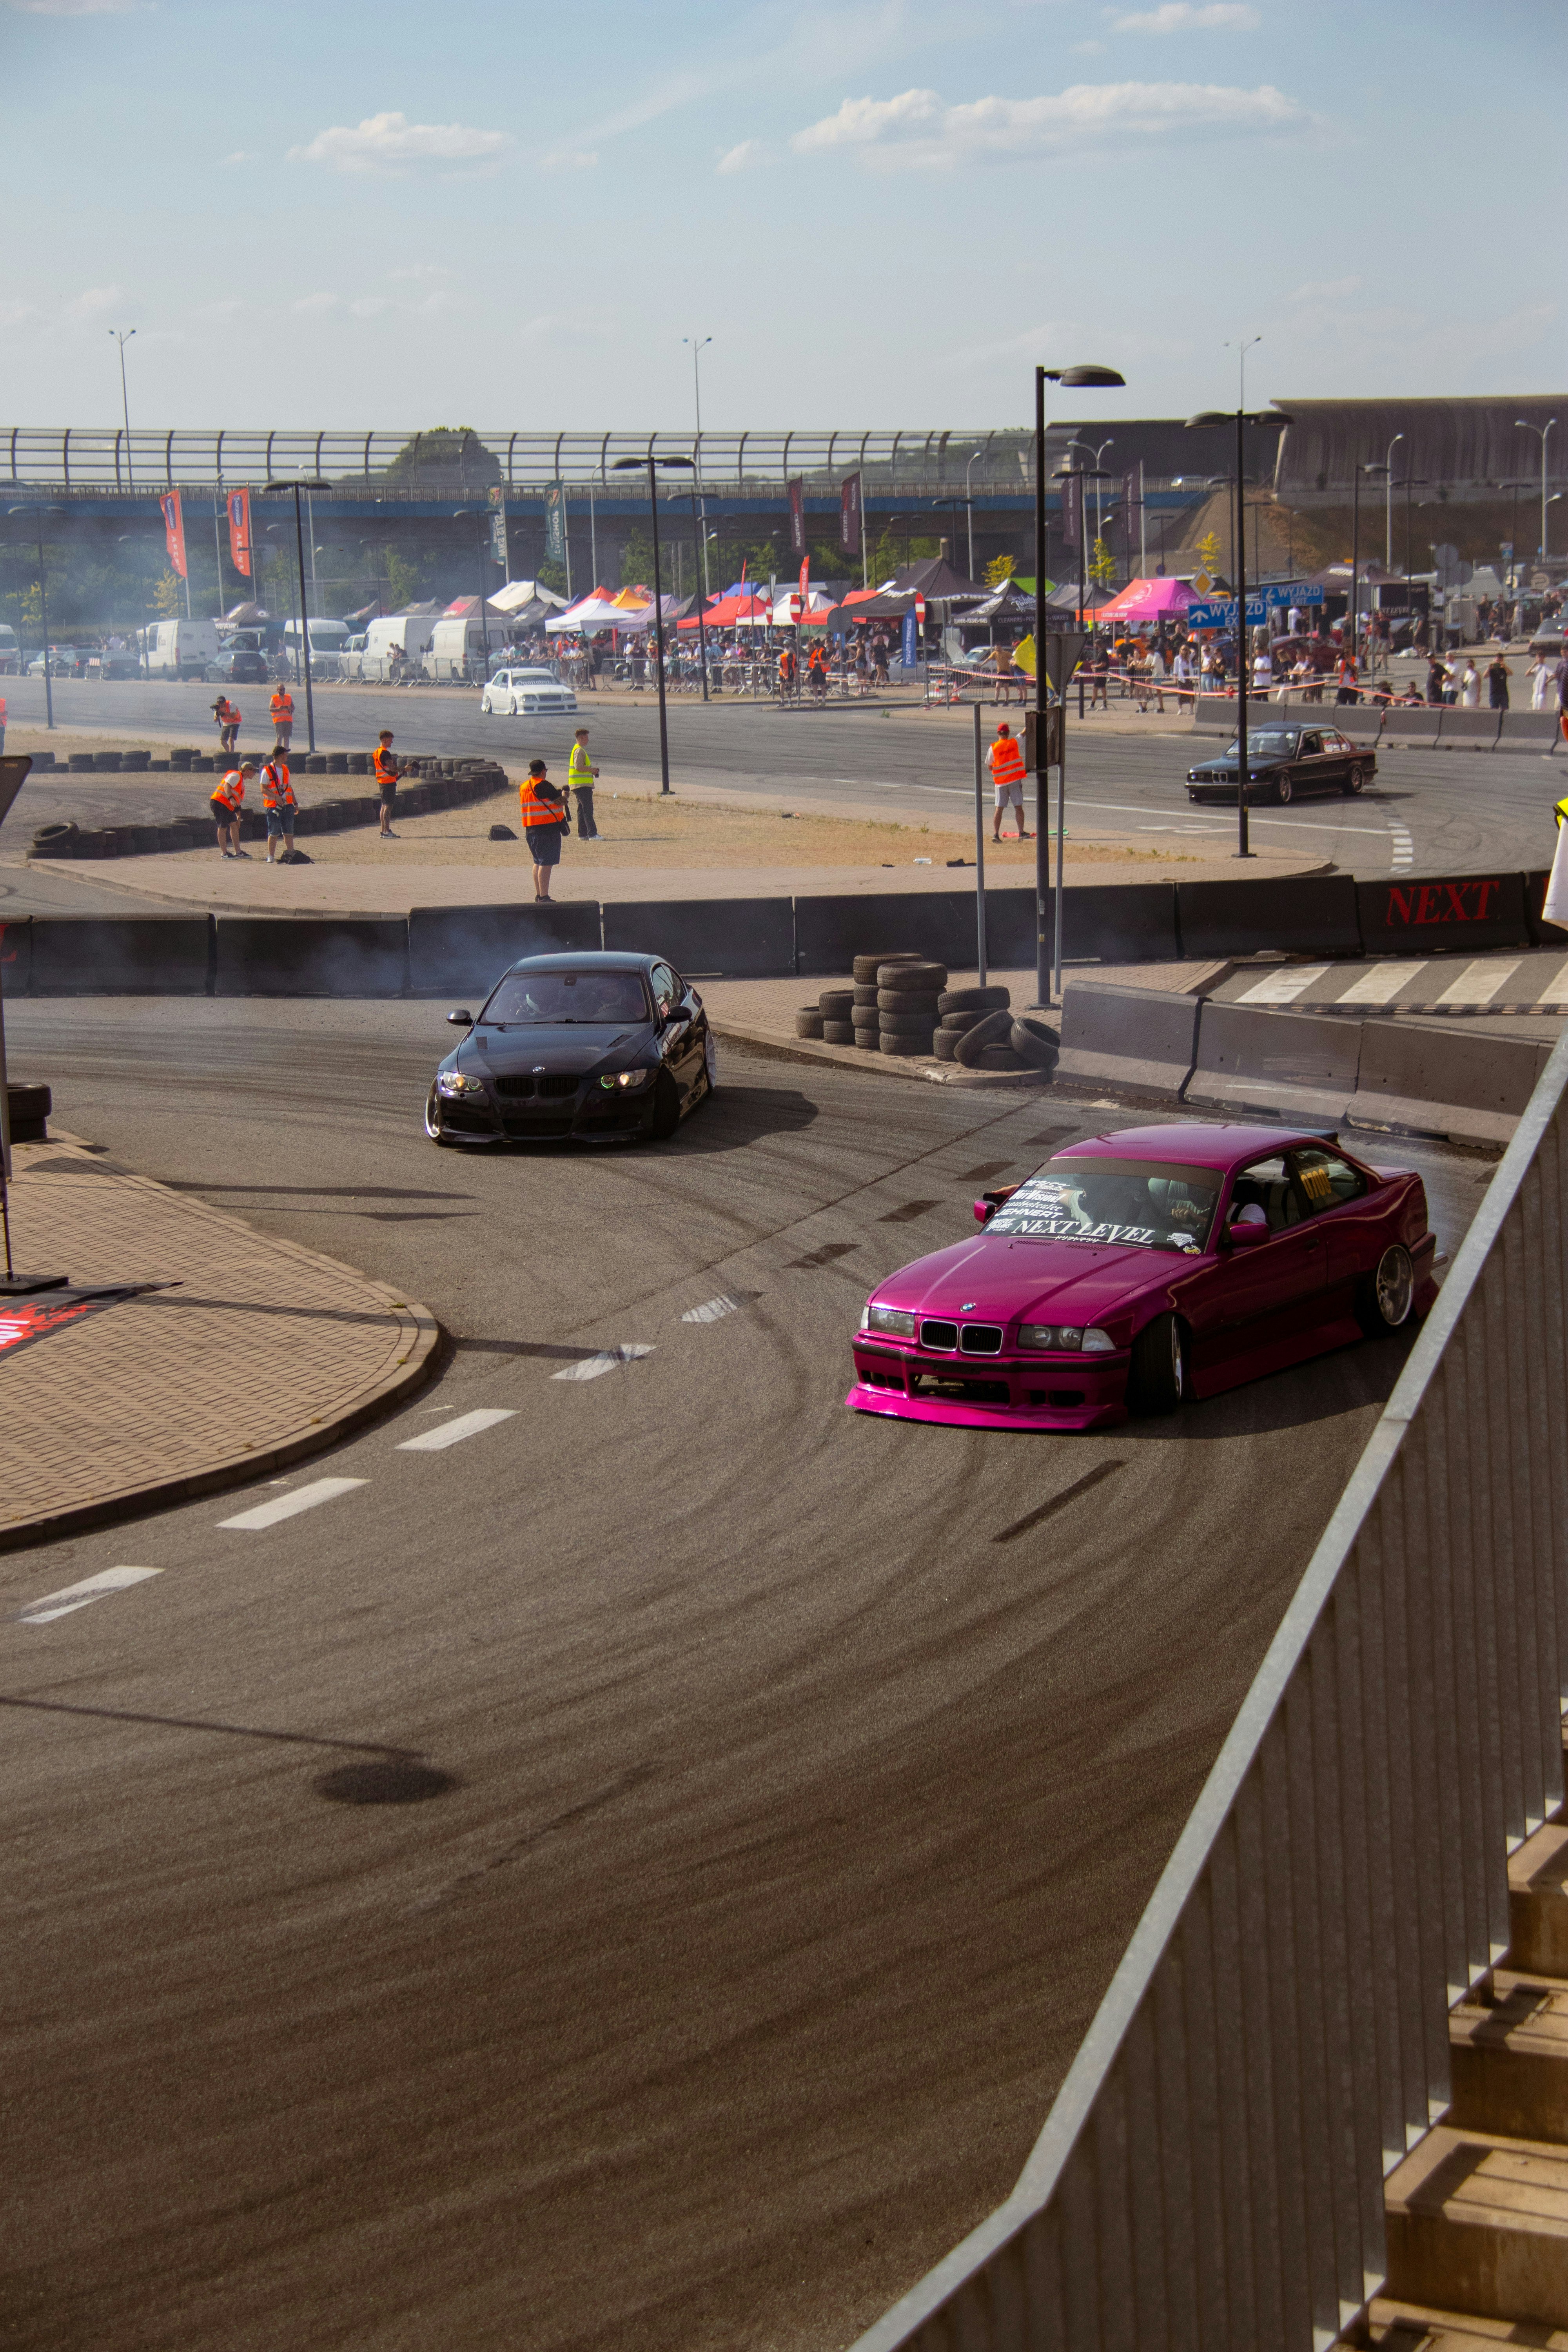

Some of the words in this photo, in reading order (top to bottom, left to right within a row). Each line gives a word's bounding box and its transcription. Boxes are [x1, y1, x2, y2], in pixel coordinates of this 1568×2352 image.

[1278, 587, 1320, 597] WYJAZD
[1209, 603, 1263, 617] WYJZD
[1385, 880, 1500, 926] NEXT
[995, 1209, 1064, 1219] JEHNERT
[1011, 1220, 1080, 1234] NEXT
[1074, 1222, 1156, 1244] LEVEL
